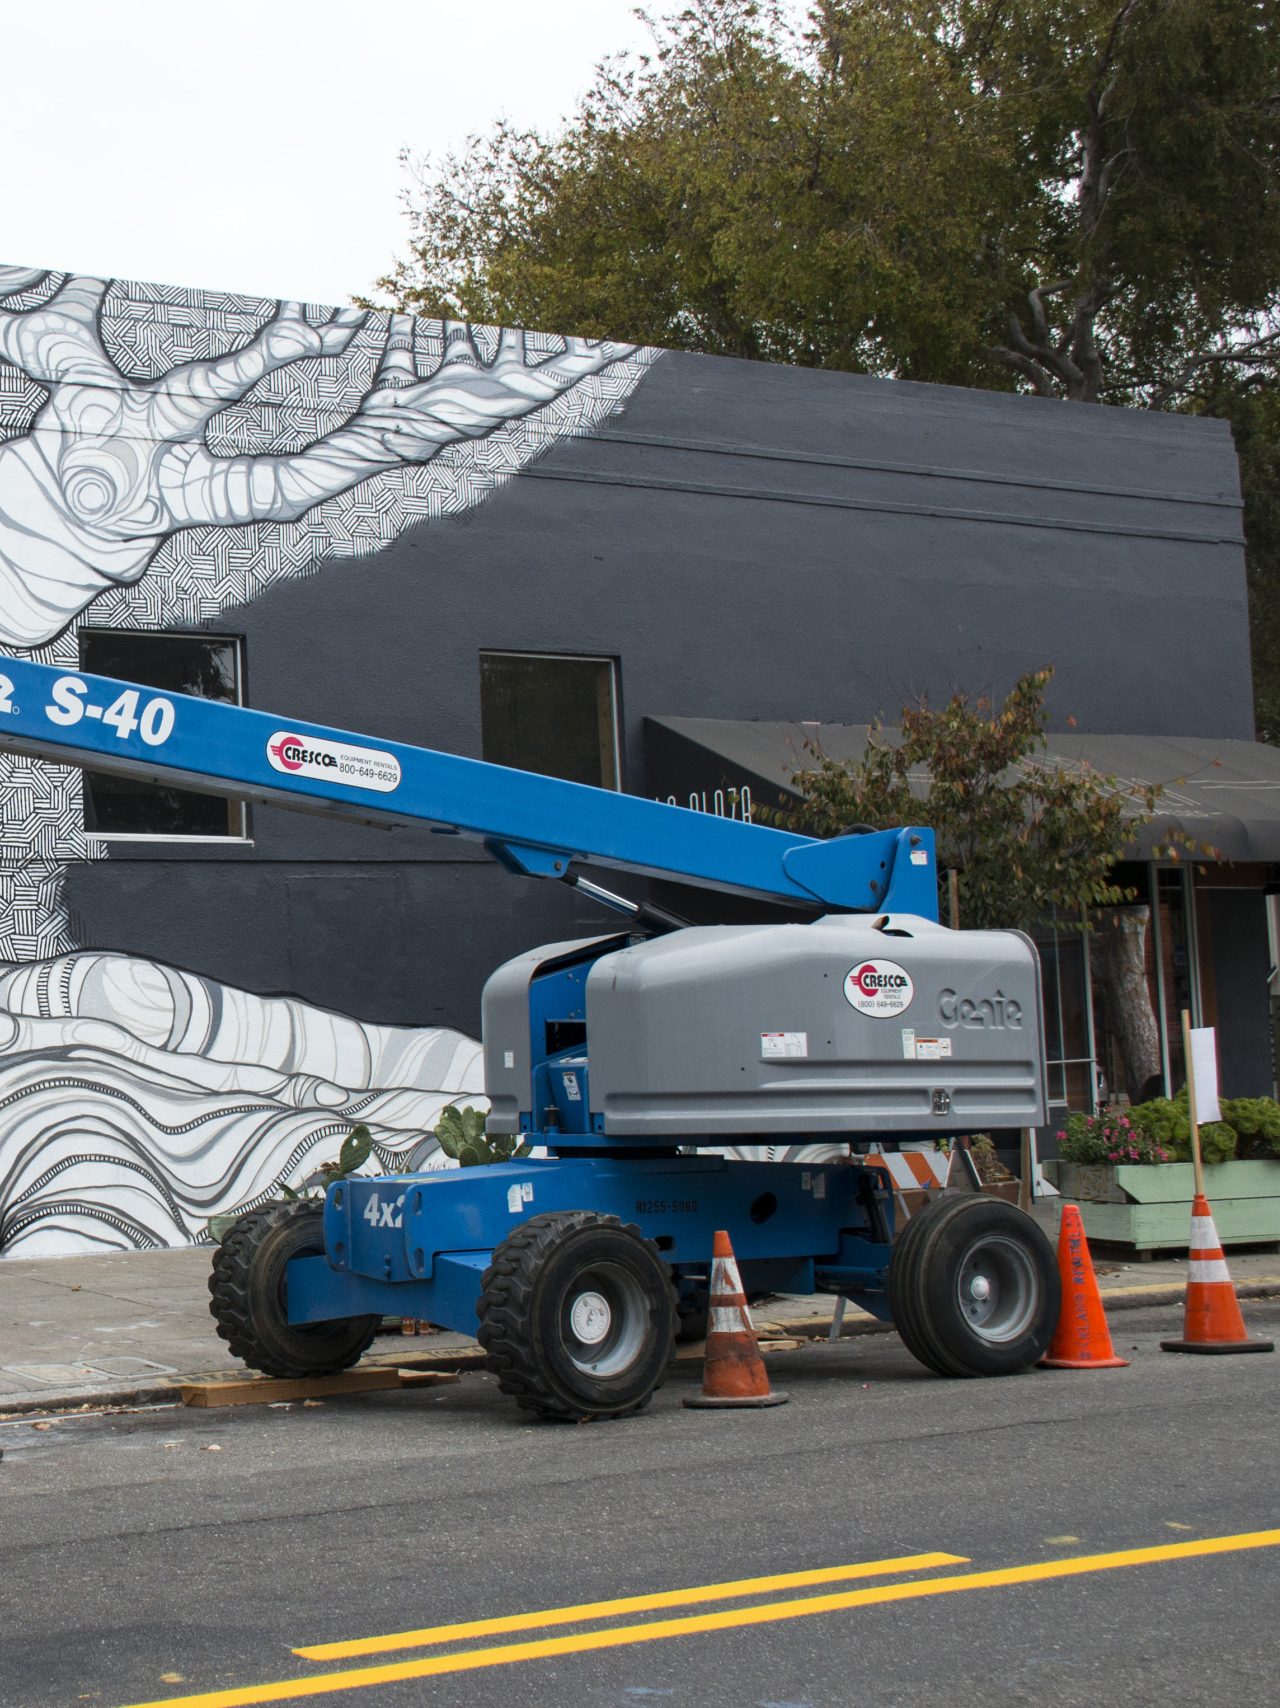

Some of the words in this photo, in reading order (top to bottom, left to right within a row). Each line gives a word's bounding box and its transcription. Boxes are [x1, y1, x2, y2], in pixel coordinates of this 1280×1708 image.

[45, 676, 176, 747] S-40
[284, 746, 338, 768] CRESCO
[340, 754, 372, 767] EQUIPMENT
[373, 761, 398, 771] RENTALS
[339, 762, 398, 783] 800-649-6629
[863, 974, 908, 988] CRESCO
[937, 988, 1023, 1031] Genie
